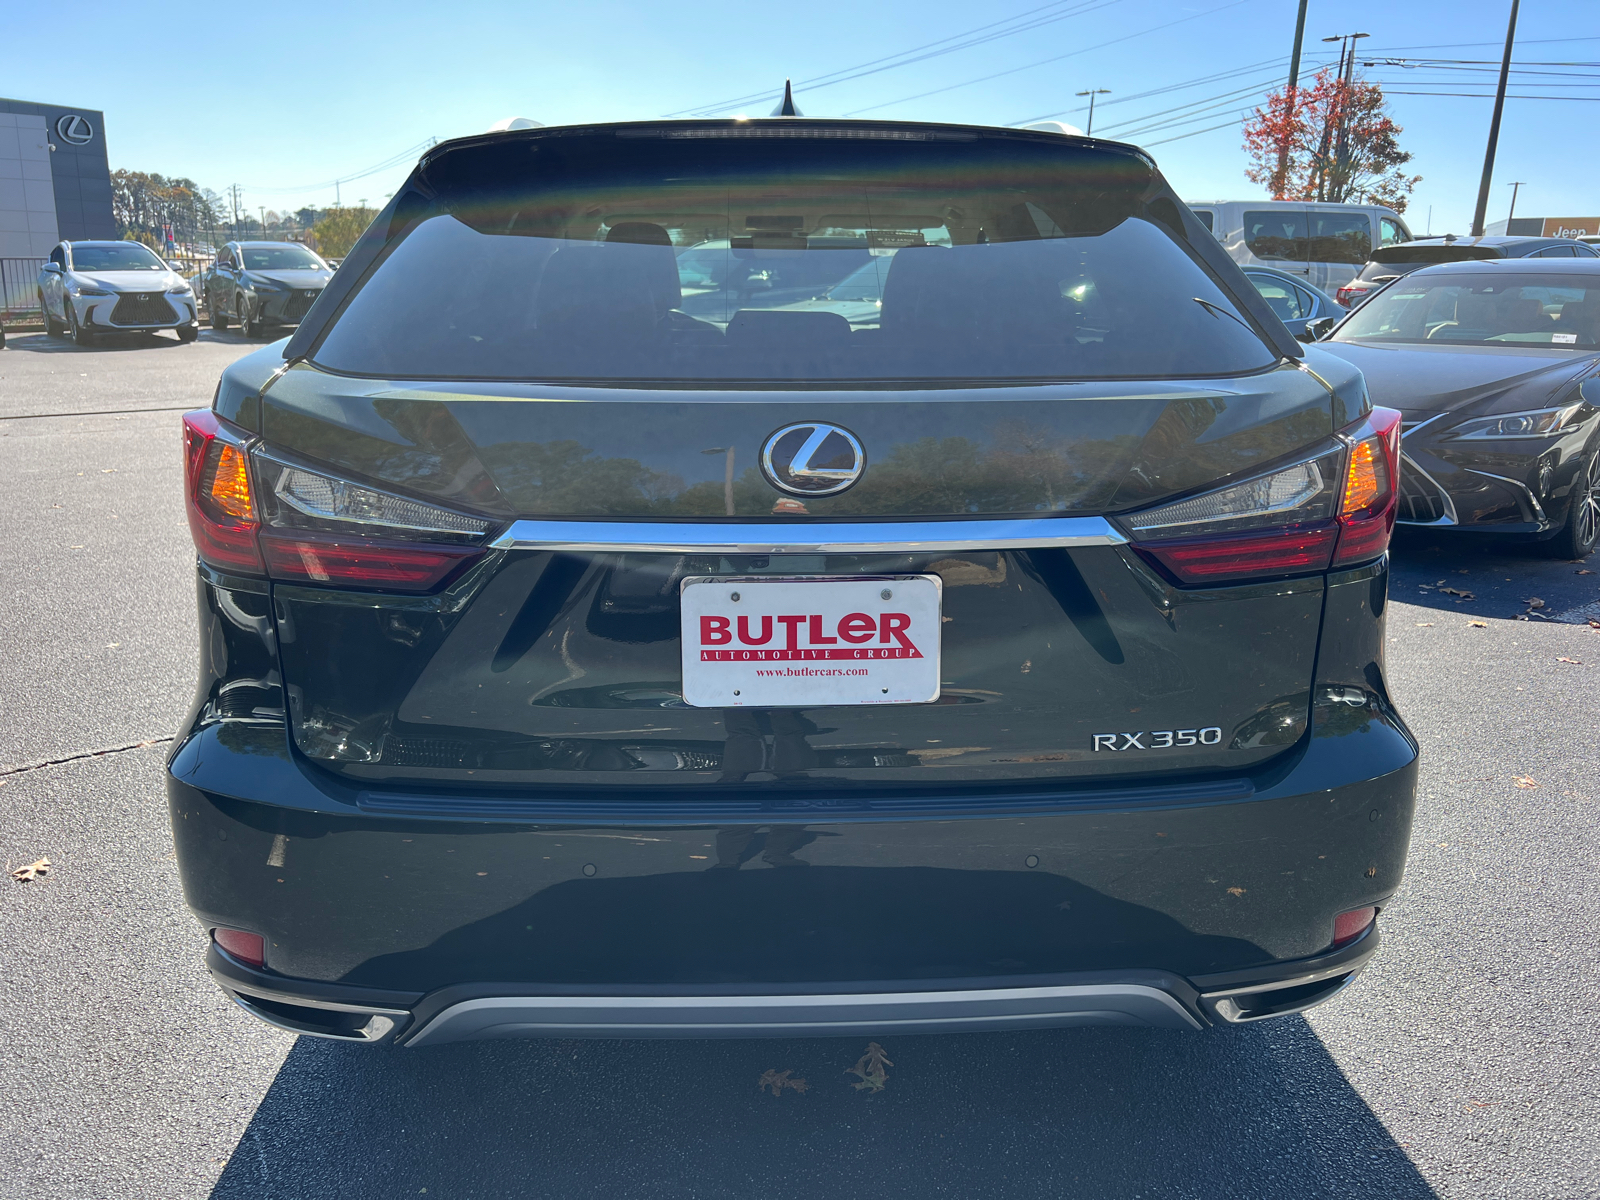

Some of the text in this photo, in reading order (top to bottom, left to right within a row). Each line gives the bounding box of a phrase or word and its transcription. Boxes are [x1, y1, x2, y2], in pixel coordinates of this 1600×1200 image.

[701, 648, 915, 660] AUTOMOTIVE GROUP
[756, 667, 869, 677] www.butlercars.com
[1092, 727, 1222, 751] RX 350
